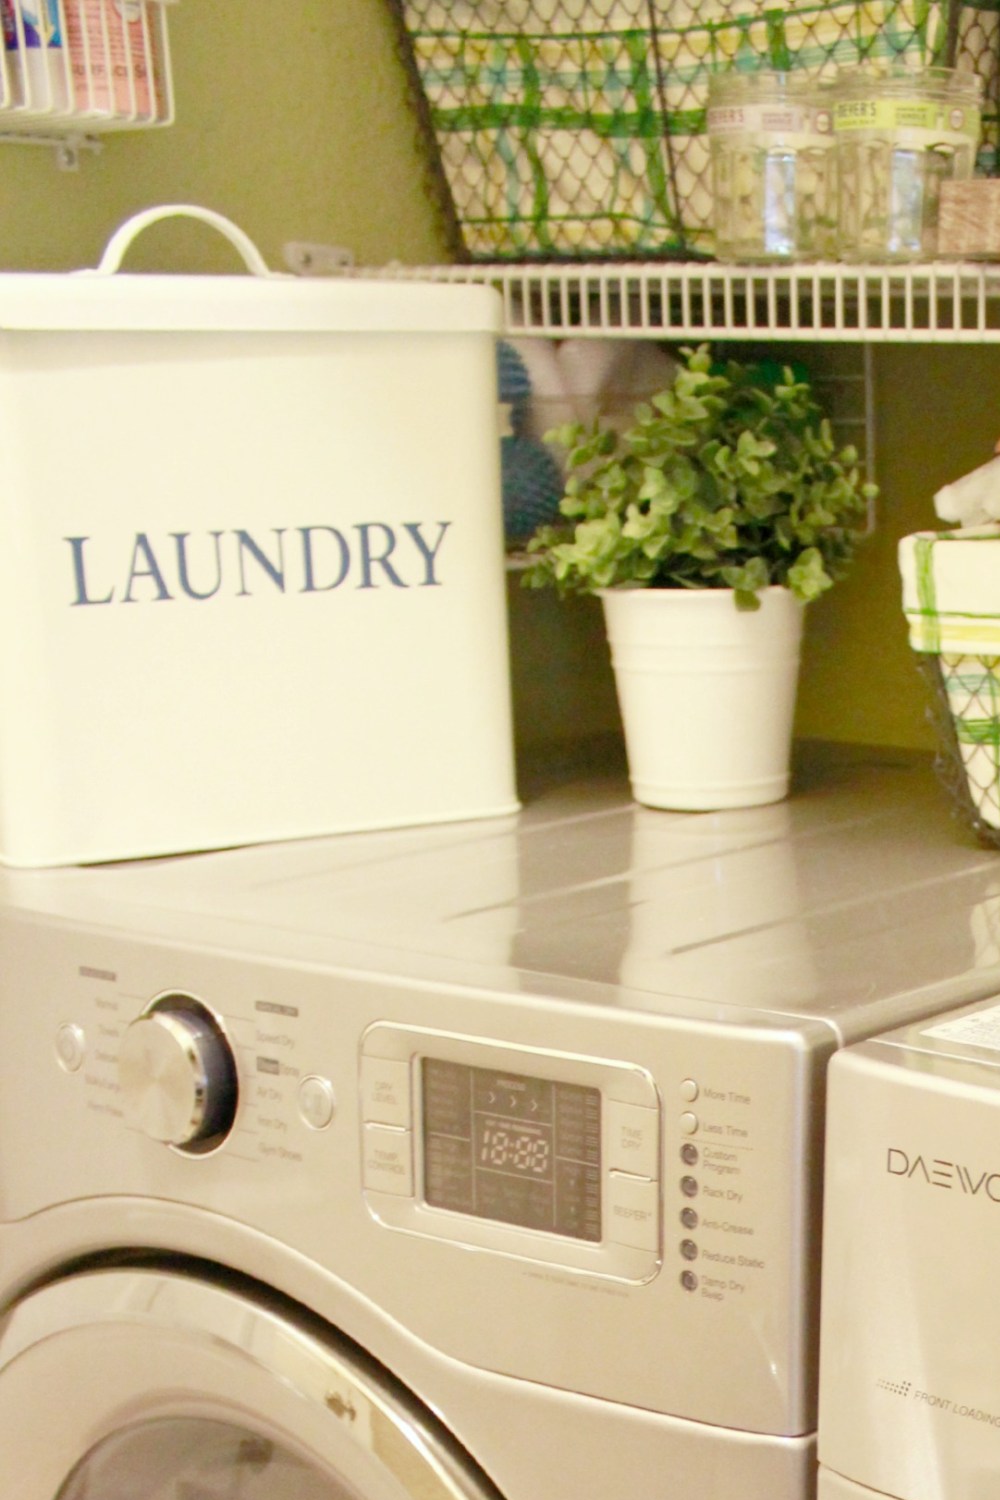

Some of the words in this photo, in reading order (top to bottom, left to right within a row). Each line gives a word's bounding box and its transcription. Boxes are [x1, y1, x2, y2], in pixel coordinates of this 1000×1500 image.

[62, 520, 453, 606] LAUNDRY
[703, 1087, 726, 1102] More
[727, 1091, 752, 1105] Time
[702, 1121, 723, 1135] Less
[725, 1124, 749, 1138] Time
[702, 1146, 738, 1161] Custom
[726, 1189, 744, 1204] Dry
[729, 1279, 746, 1295] Dry
[913, 1390, 952, 1411] FRONT
